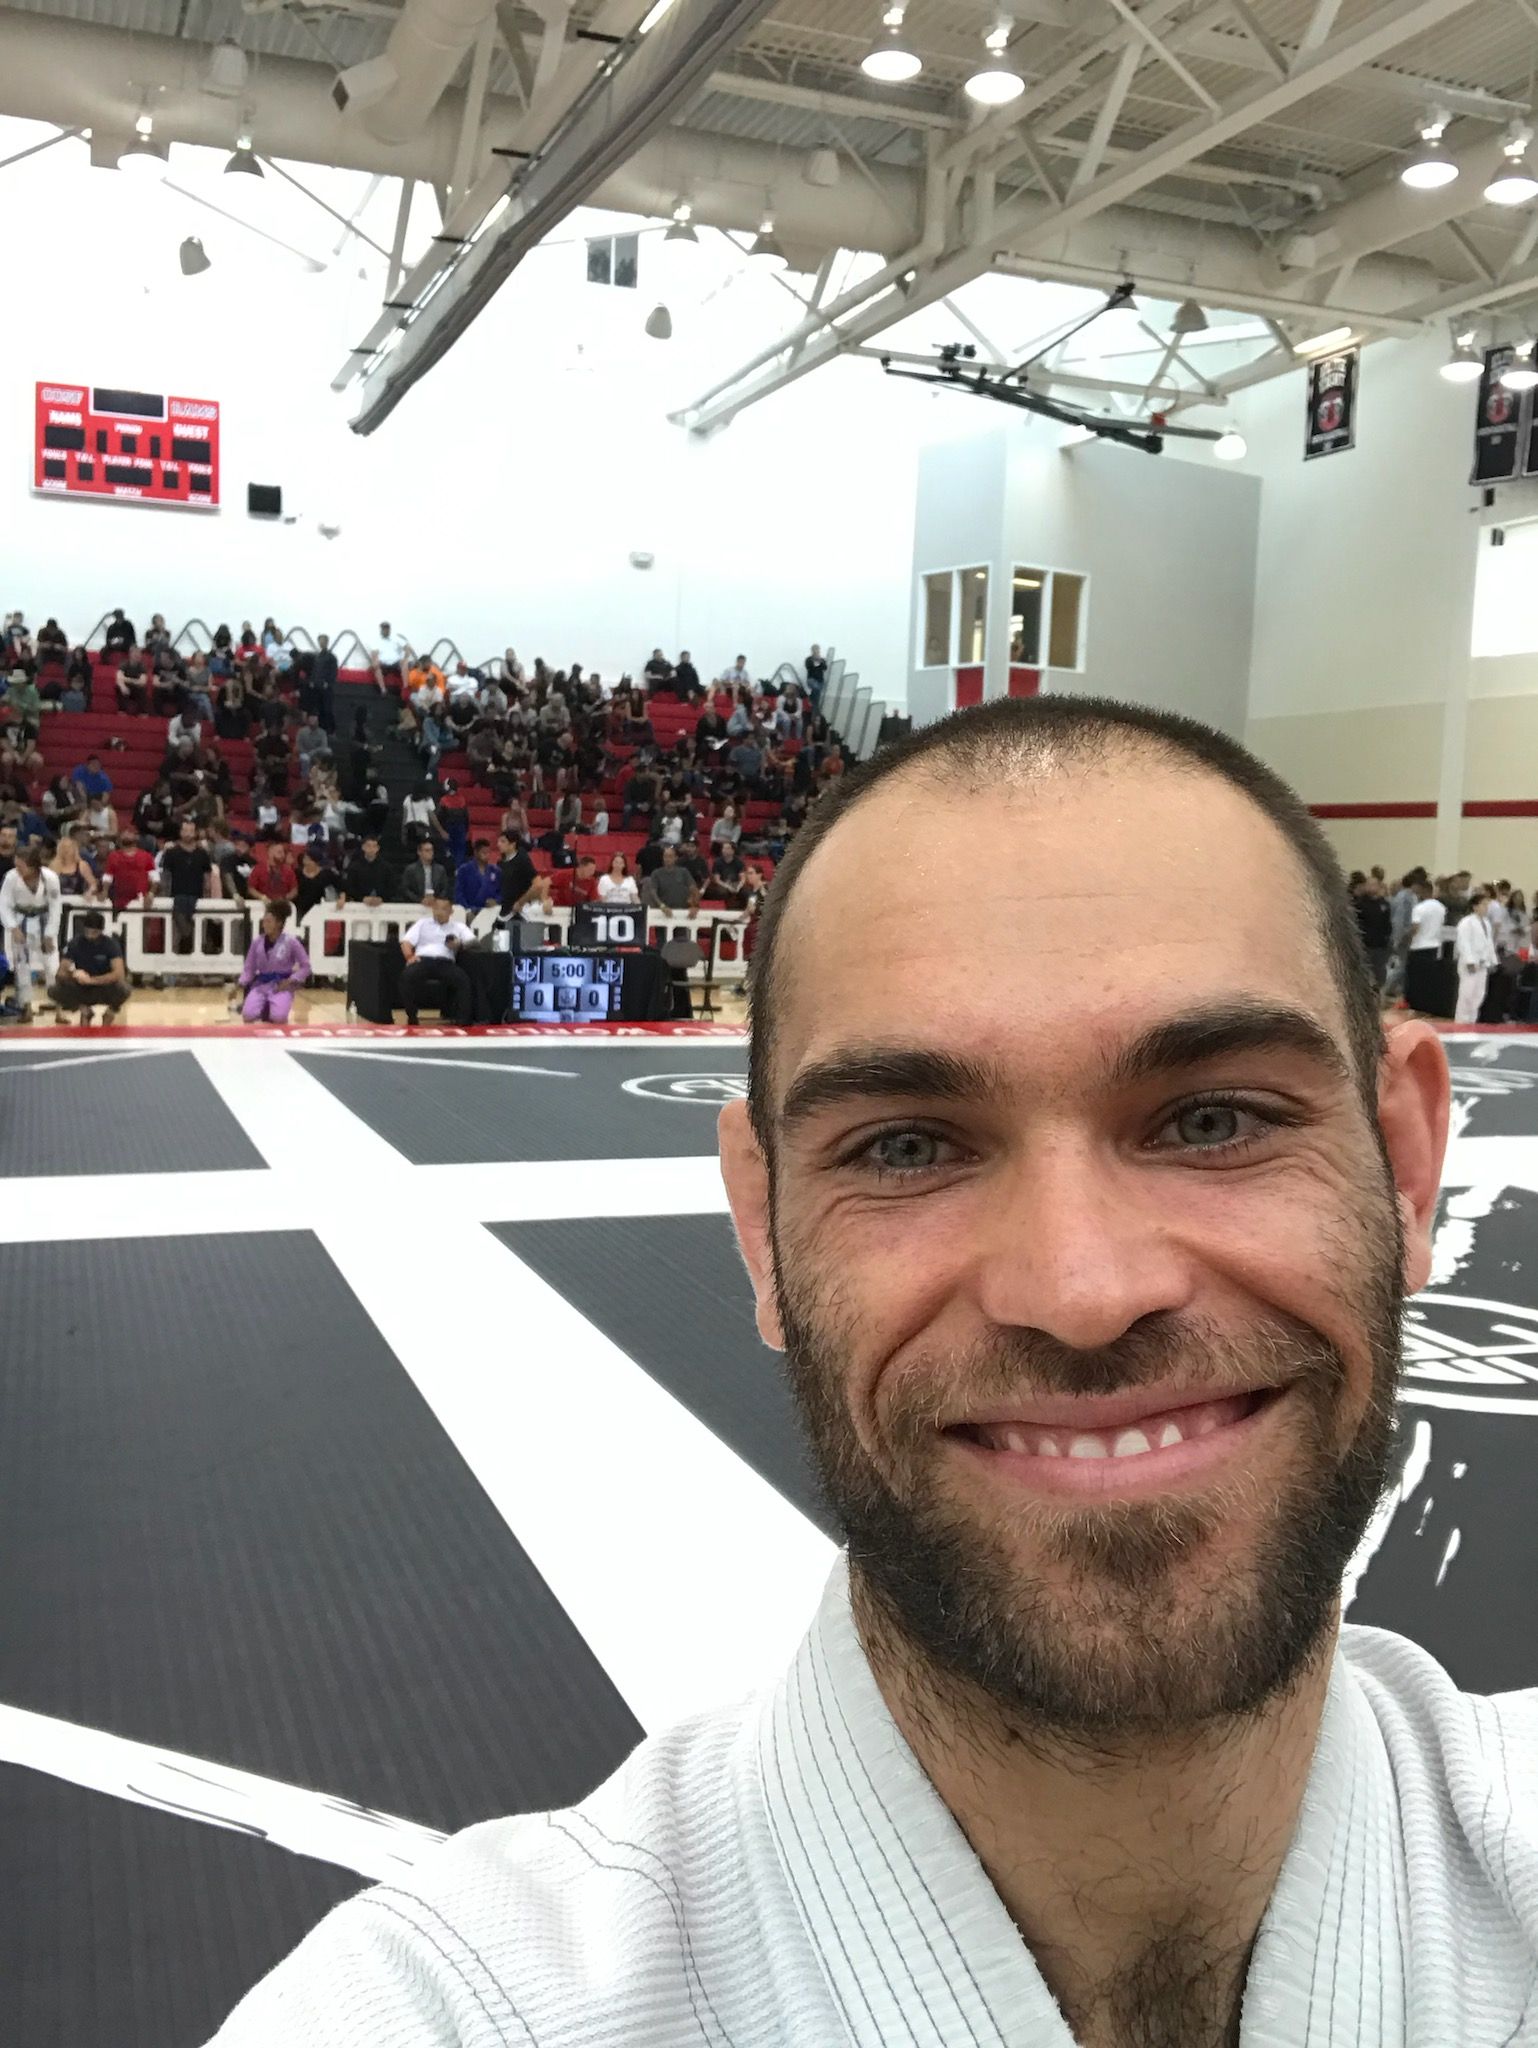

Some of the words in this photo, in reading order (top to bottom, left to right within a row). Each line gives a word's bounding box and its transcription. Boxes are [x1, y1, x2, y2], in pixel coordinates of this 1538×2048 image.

[591, 915, 635, 942] 10
[551, 963, 586, 978] 5:00
[533, 989, 544, 1006] 0
[589, 990, 600, 1007] 0
